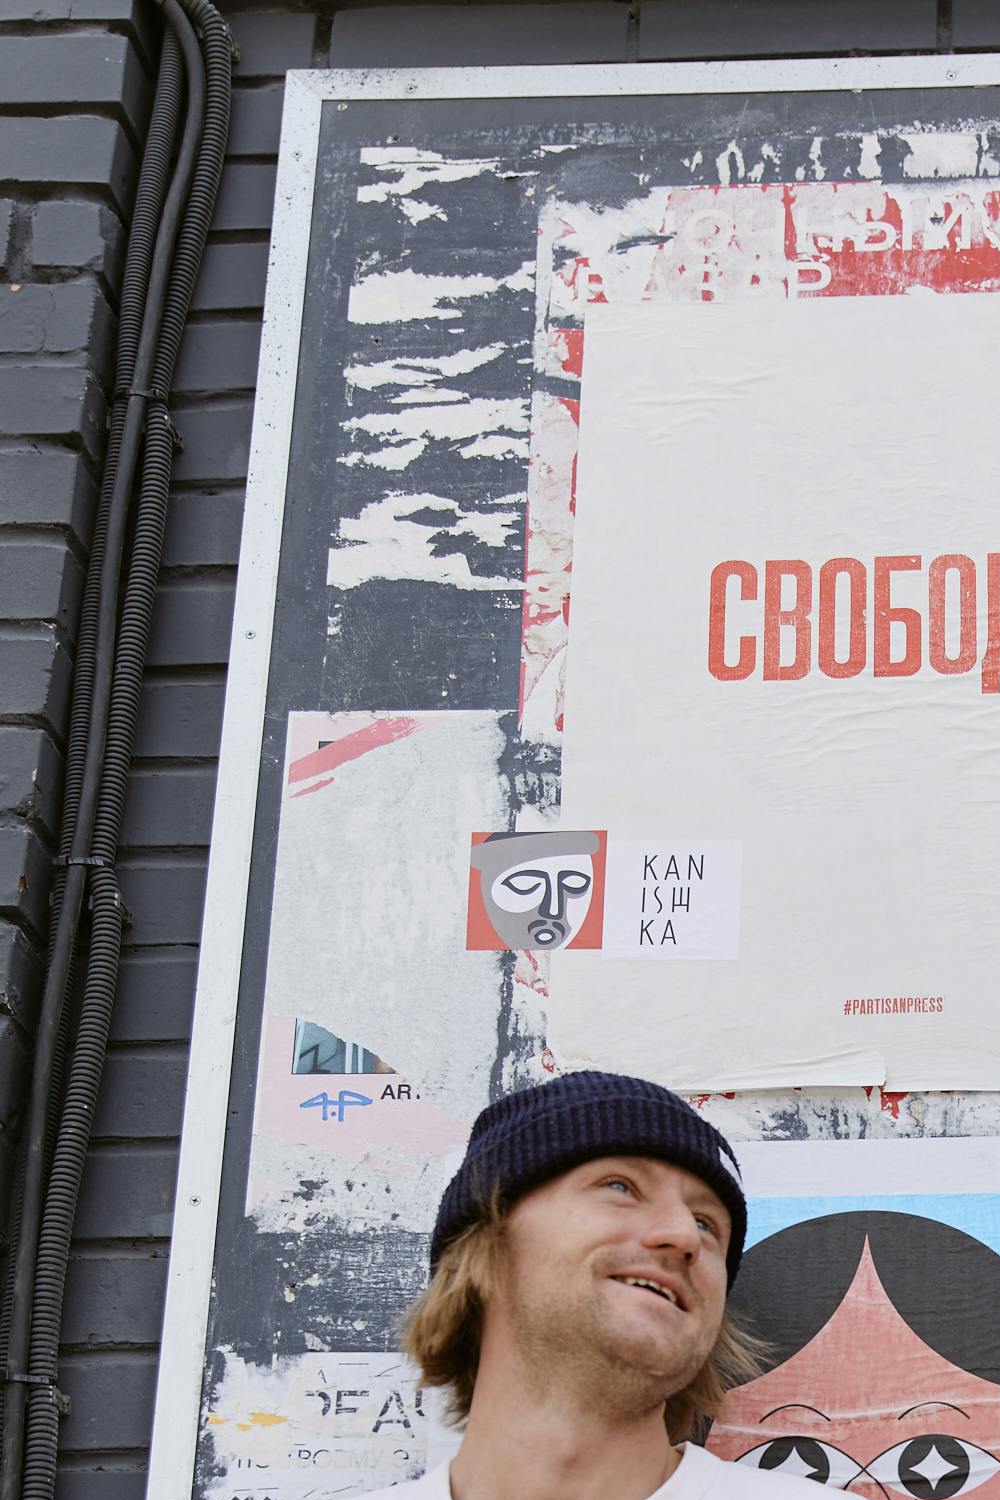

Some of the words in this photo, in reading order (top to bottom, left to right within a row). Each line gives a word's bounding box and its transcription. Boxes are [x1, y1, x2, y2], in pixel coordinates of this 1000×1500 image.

[643, 854, 704, 880] KAN
[640, 919, 677, 945] KA
[843, 997, 944, 1015] #PARTISANPRESS
